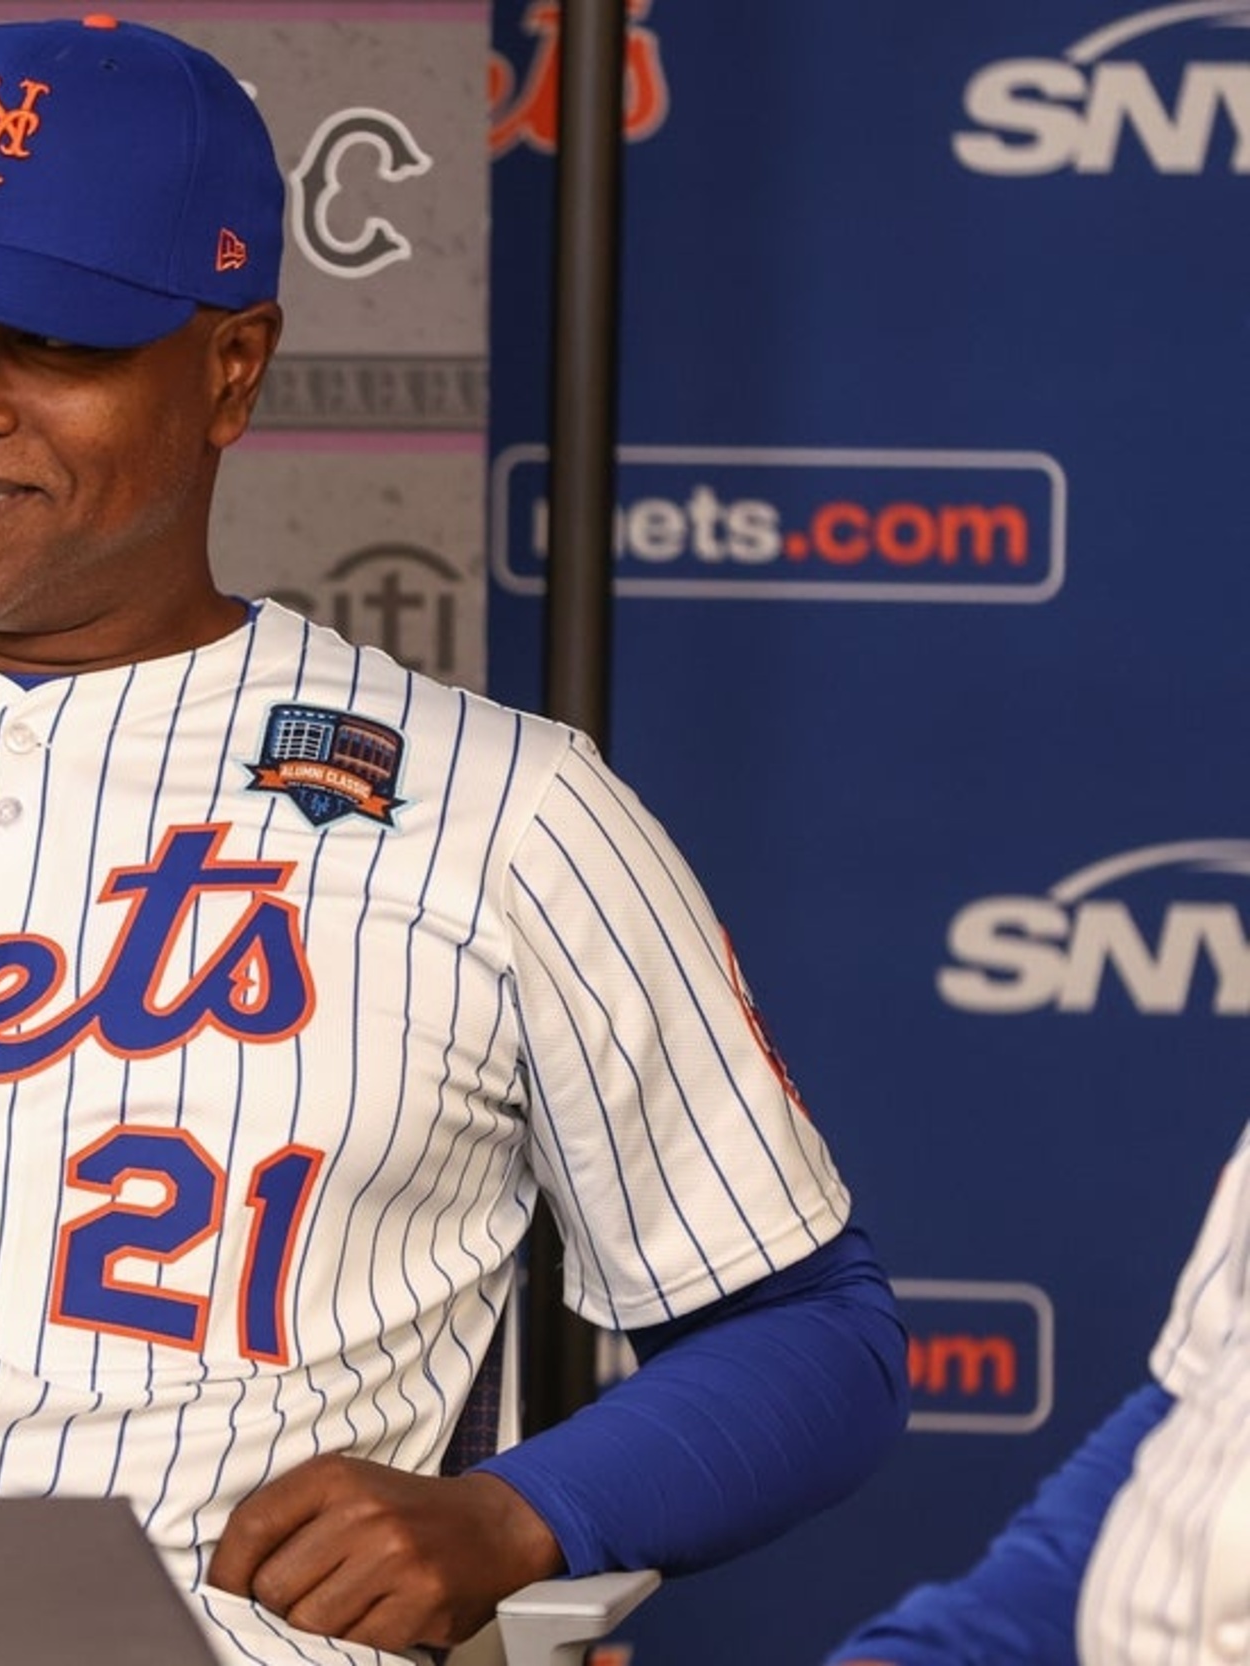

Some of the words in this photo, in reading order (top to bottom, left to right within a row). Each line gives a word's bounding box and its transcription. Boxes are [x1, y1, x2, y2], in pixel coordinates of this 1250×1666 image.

[533, 485, 1029, 565] ets.com
[264, 542, 462, 673] iti
[50, 1123, 325, 1368] 21
